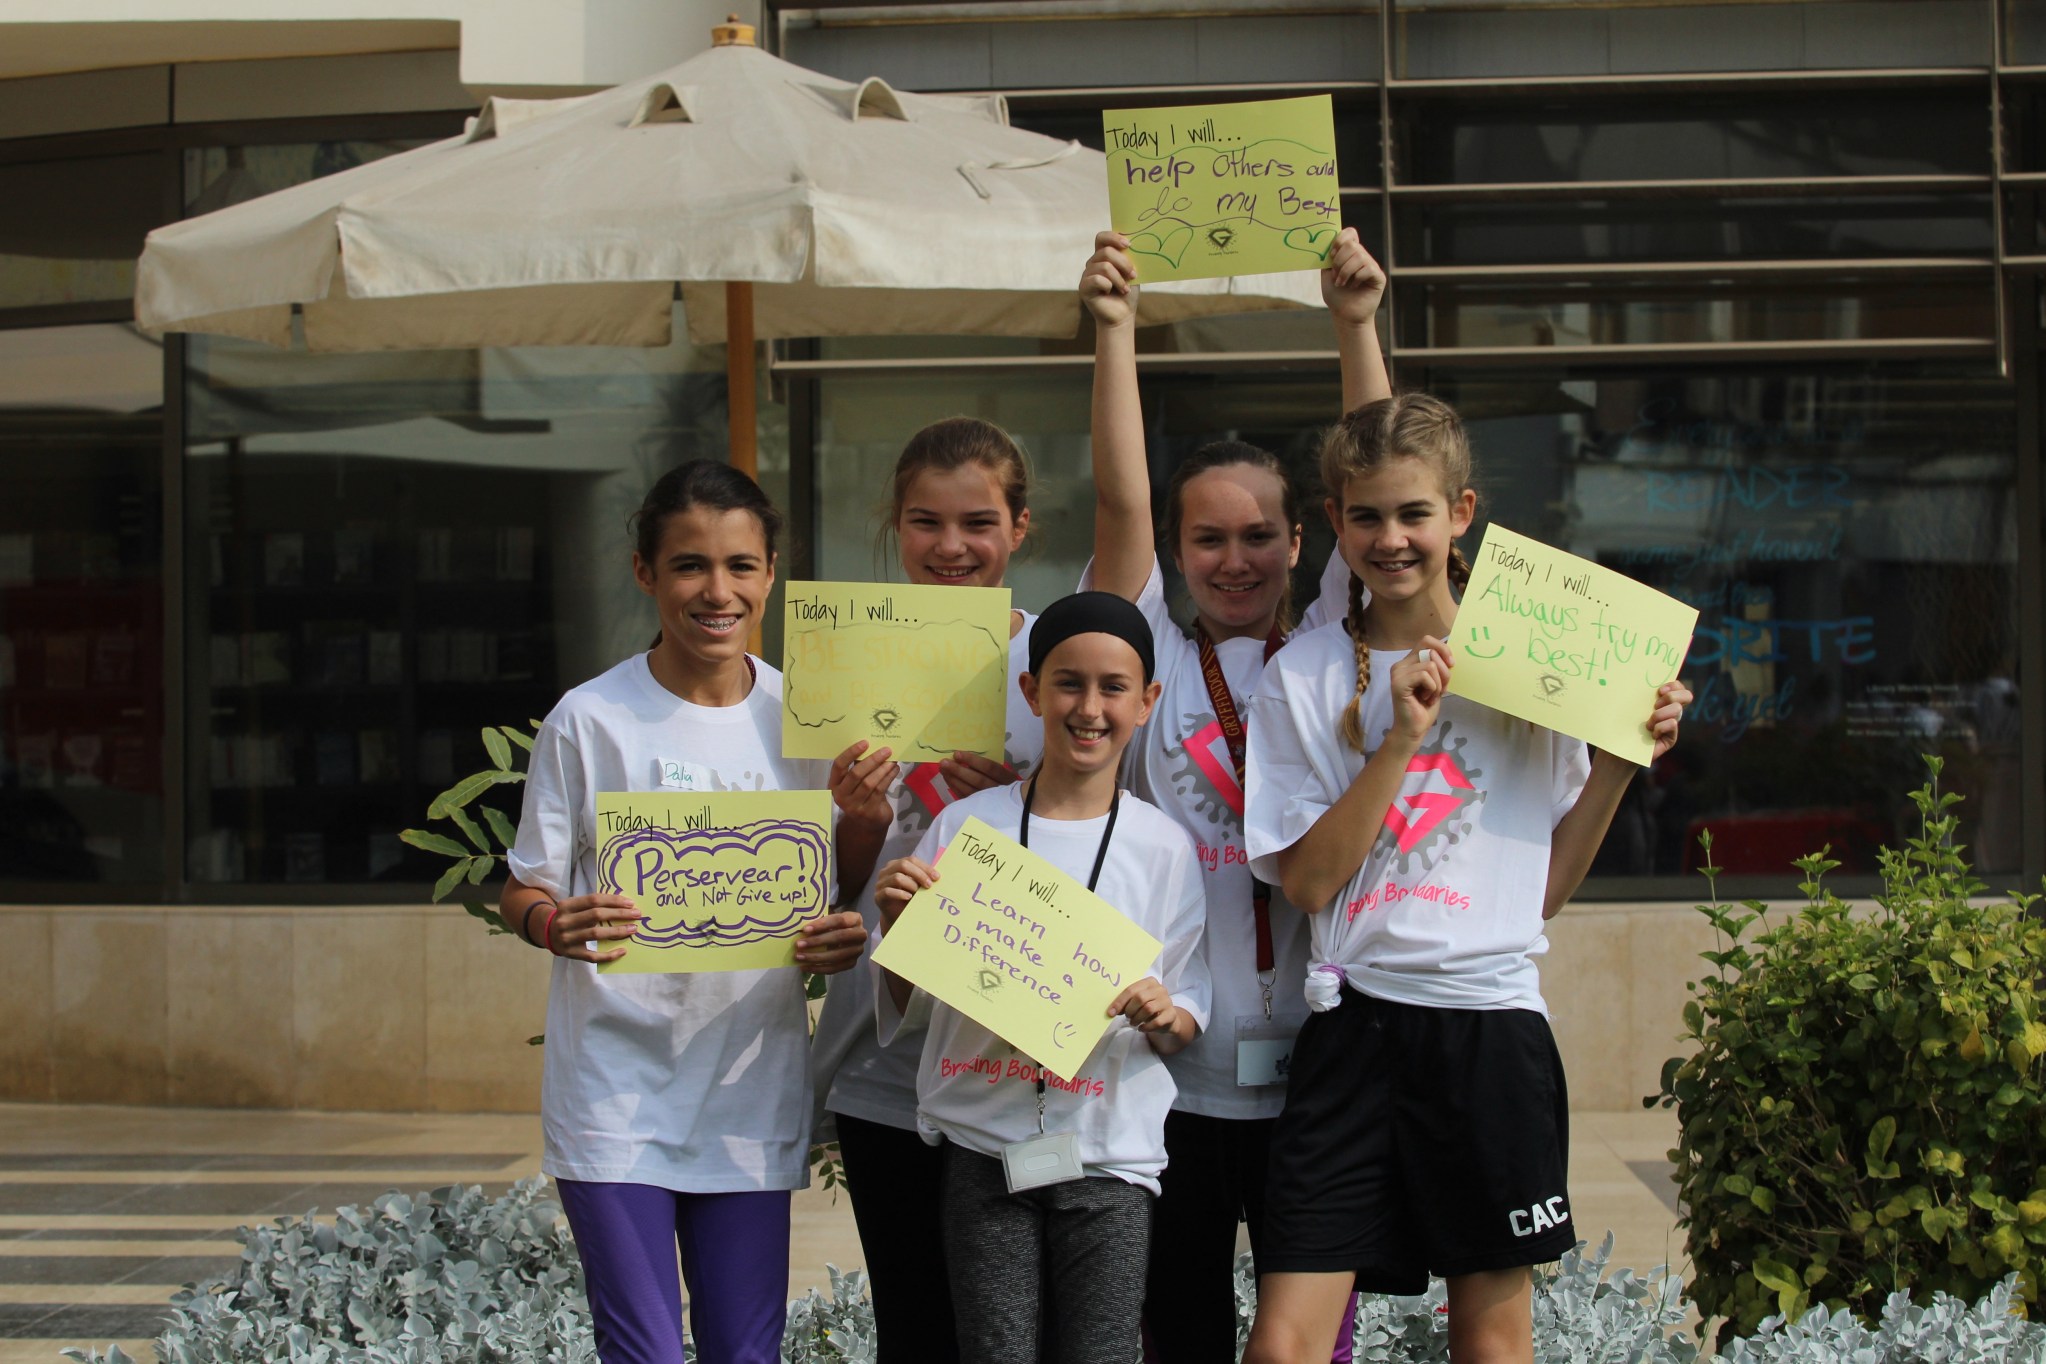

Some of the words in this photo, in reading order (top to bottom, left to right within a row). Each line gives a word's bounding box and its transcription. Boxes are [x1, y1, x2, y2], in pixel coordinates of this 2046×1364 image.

[1106, 122, 1159, 157] Today
[1170, 123, 1176, 145] I
[1126, 156, 1195, 188] help
[1212, 146, 1296, 178] Others
[1216, 191, 1257, 225] my
[1278, 186, 1340, 220] Best
[1646, 464, 1855, 514] READER
[1486, 541, 1536, 585] Today
[1545, 563, 1552, 583] I
[787, 594, 838, 630] Today
[850, 599, 854, 620] I
[1479, 573, 1579, 640] Always
[1590, 608, 1637, 663] try
[1645, 636, 1680, 688] my
[799, 630, 853, 674] BE
[863, 635, 998, 674] STRONG
[1528, 628, 1610, 686] best!
[1206, 665, 1241, 736] GRYFFINDOR
[665, 762, 694, 783] Dalia
[598, 806, 654, 841] Today
[667, 809, 671, 830] I
[634, 846, 807, 897] Perservear!
[961, 832, 1007, 881] Today
[1011, 864, 1024, 882] I
[656, 888, 689, 907] and
[702, 886, 733, 907] Not
[736, 886, 776, 906] Give
[780, 886, 807, 905] up!
[935, 893, 961, 916] To
[976, 921, 1044, 967] make
[1062, 973, 1074, 989] a
[971, 882, 1046, 940] Learn
[1072, 942, 1121, 987] how
[943, 924, 1062, 1005] Difference
[1508, 1195, 1569, 1237] CAC
